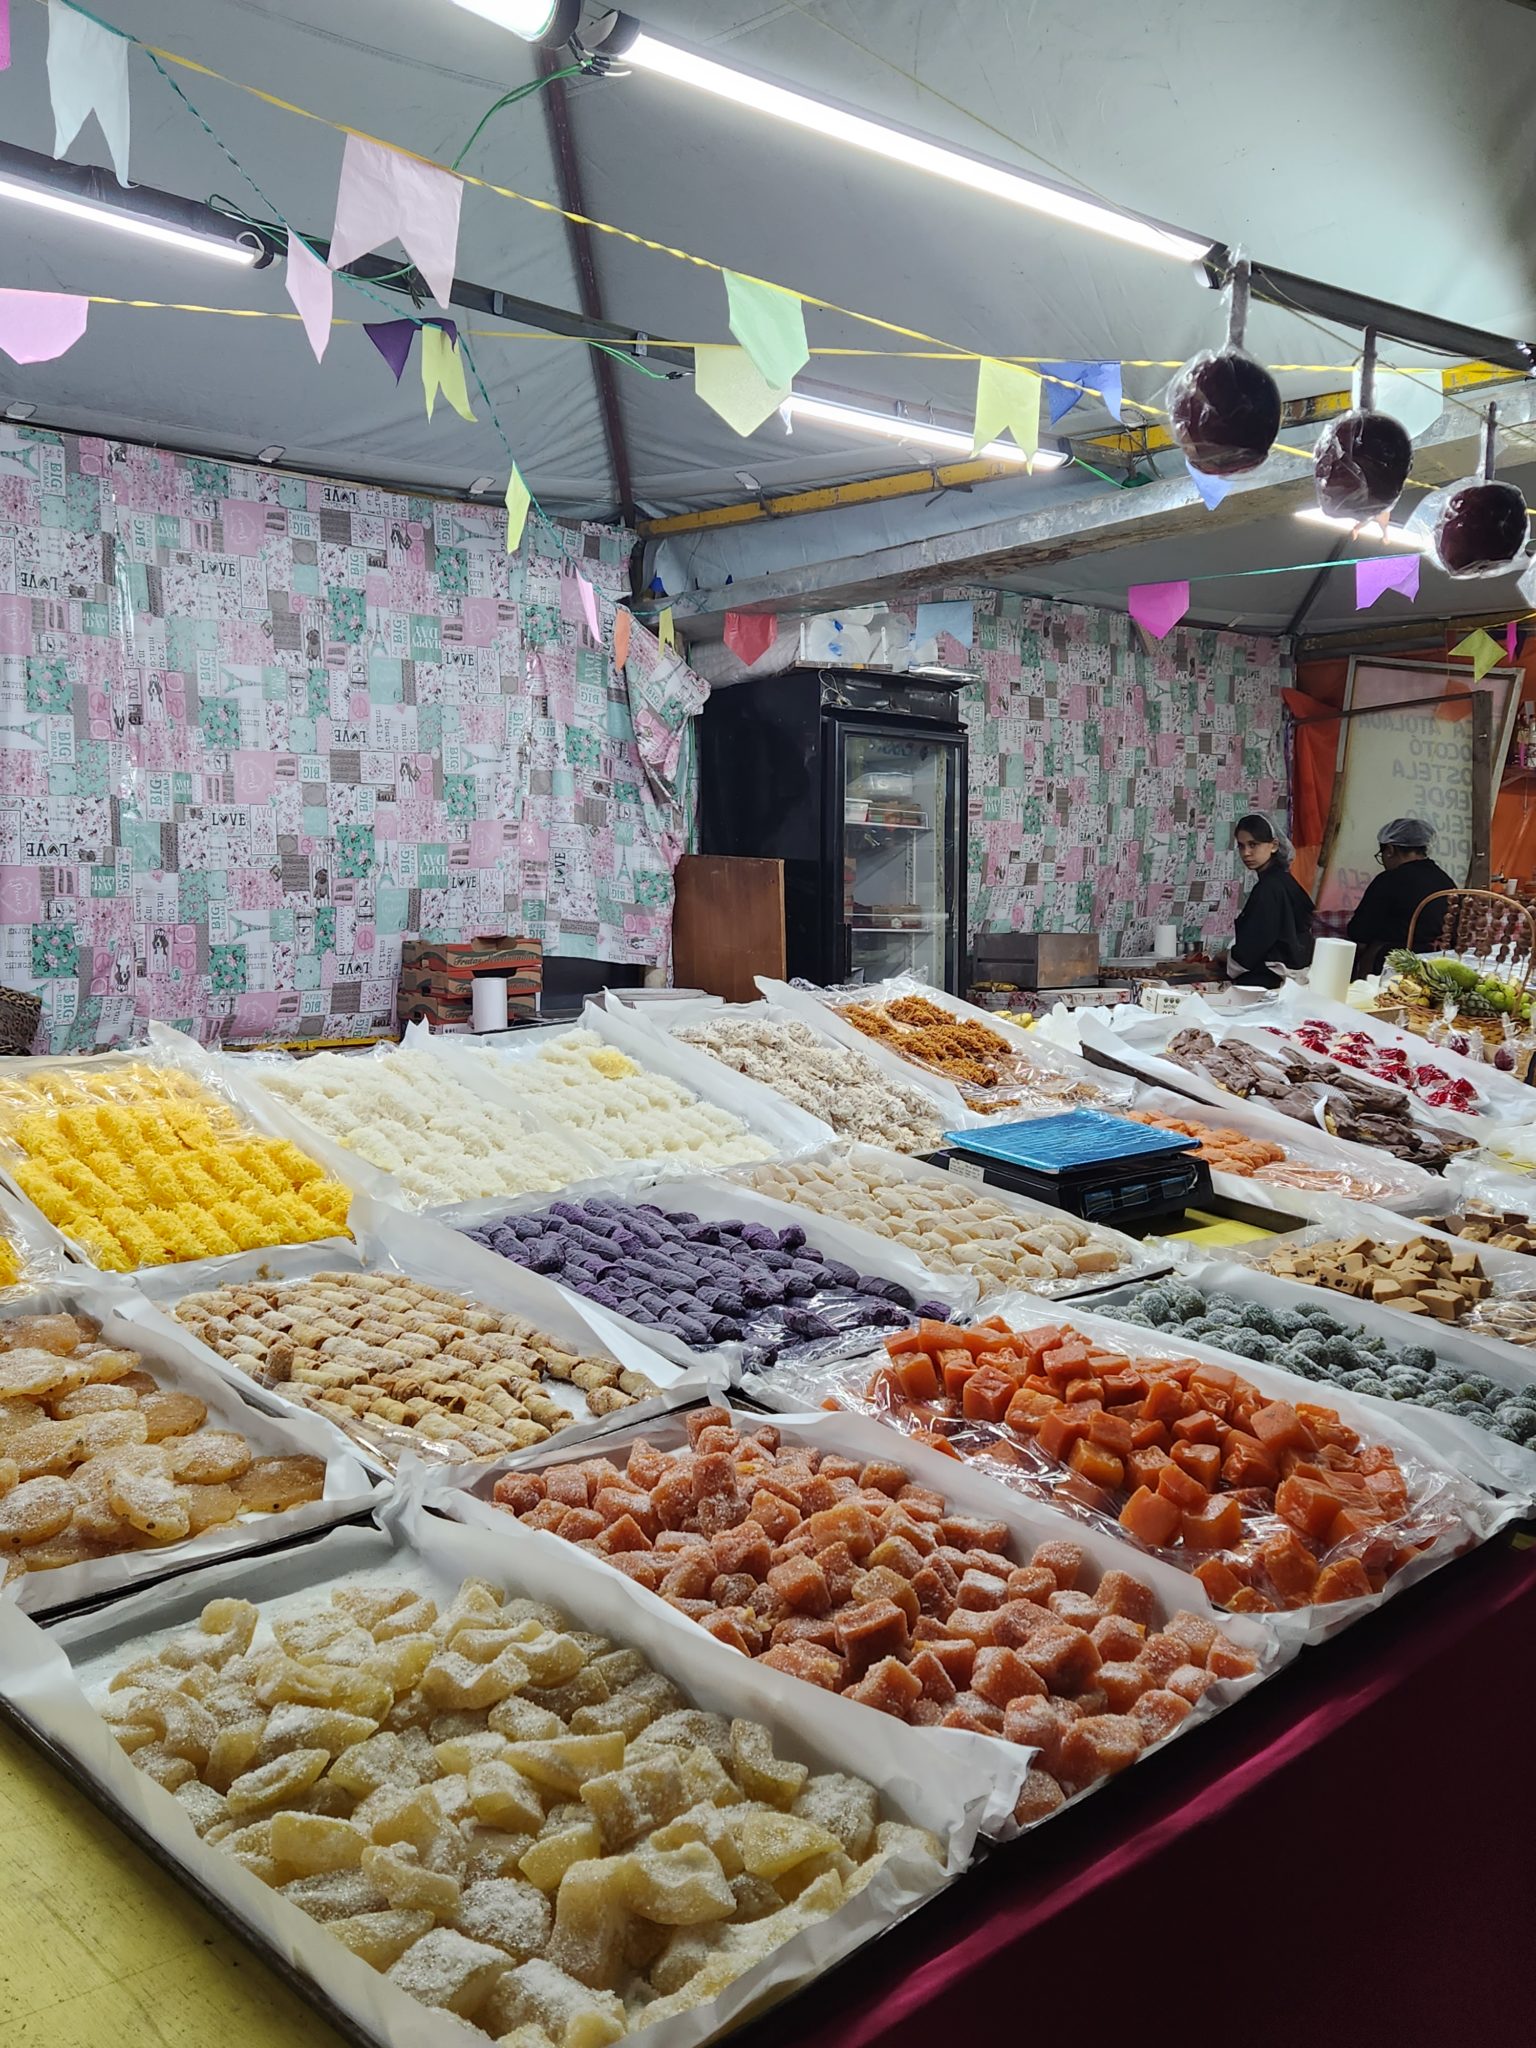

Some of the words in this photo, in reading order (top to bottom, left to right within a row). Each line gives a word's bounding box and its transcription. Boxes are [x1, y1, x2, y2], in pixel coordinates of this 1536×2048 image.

[50, 462, 62, 489] BIG
[134, 520, 146, 547] BIG
[293, 522, 310, 537] BIG
[442, 518, 451, 545] BIG
[351, 553, 359, 576] BIG
[393, 613, 402, 643] BIG
[415, 625, 438, 636] DAY
[412, 636, 440, 649] HAPPY
[201, 657, 211, 681] BIG
[580, 690, 599, 703] BIG
[539, 726, 556, 737] BIG
[60, 731, 71, 758] BIG
[450, 746, 459, 770] BIG
[303, 766, 320, 779] BIG
[150, 779, 163, 806] BIG
[359, 790, 368, 812] BIG
[401, 850, 410, 874] BIG
[419, 865, 448, 876] HAPPY
[423, 854, 446, 866] DAY
[121, 863, 129, 890] BIG
[211, 906, 220, 930] BIG
[529, 929, 545, 939] BIG
[63, 994, 75, 1020] BIG
[304, 1002, 320, 1013] BIG
